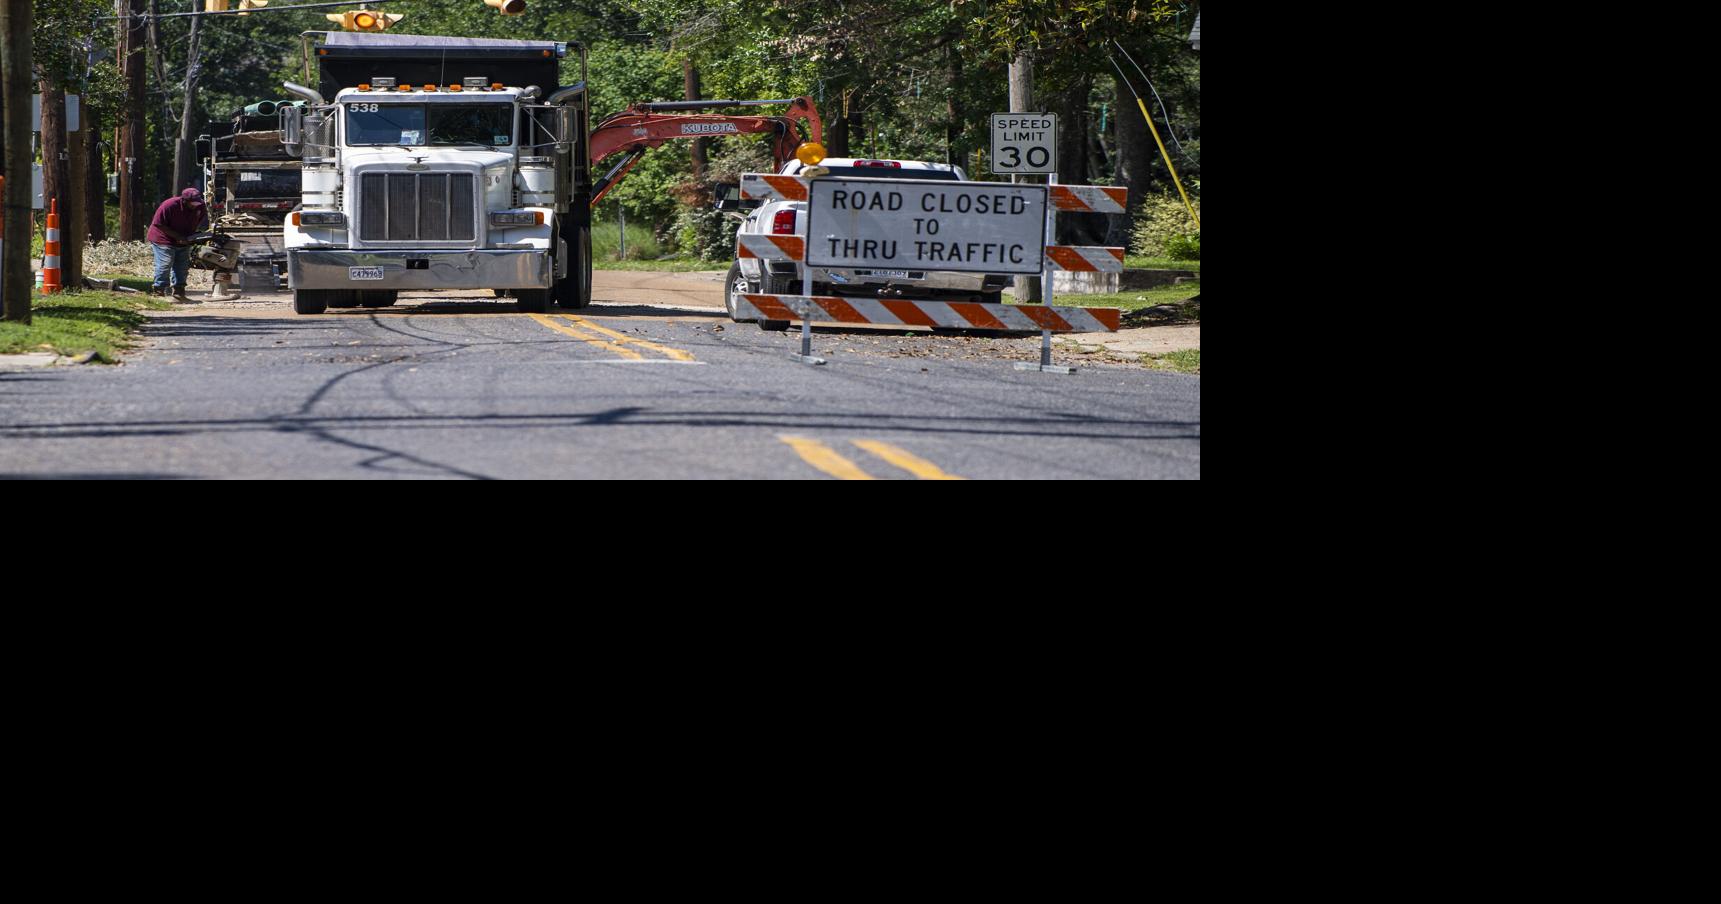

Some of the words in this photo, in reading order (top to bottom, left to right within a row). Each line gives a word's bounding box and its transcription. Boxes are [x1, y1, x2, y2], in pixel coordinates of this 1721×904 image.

[350, 103, 379, 113] 538
[681, 123, 737, 134] KUBOTA
[998, 119, 1051, 129] SPEED
[1003, 131, 1045, 141] LIMIT
[999, 146, 1050, 168] 30
[832, 190, 903, 211] ROAD
[921, 193, 1025, 215] CLOSED
[913, 218, 939, 235] TO
[828, 238, 897, 260] THRU
[914, 241, 1024, 264] TRAFFIC
